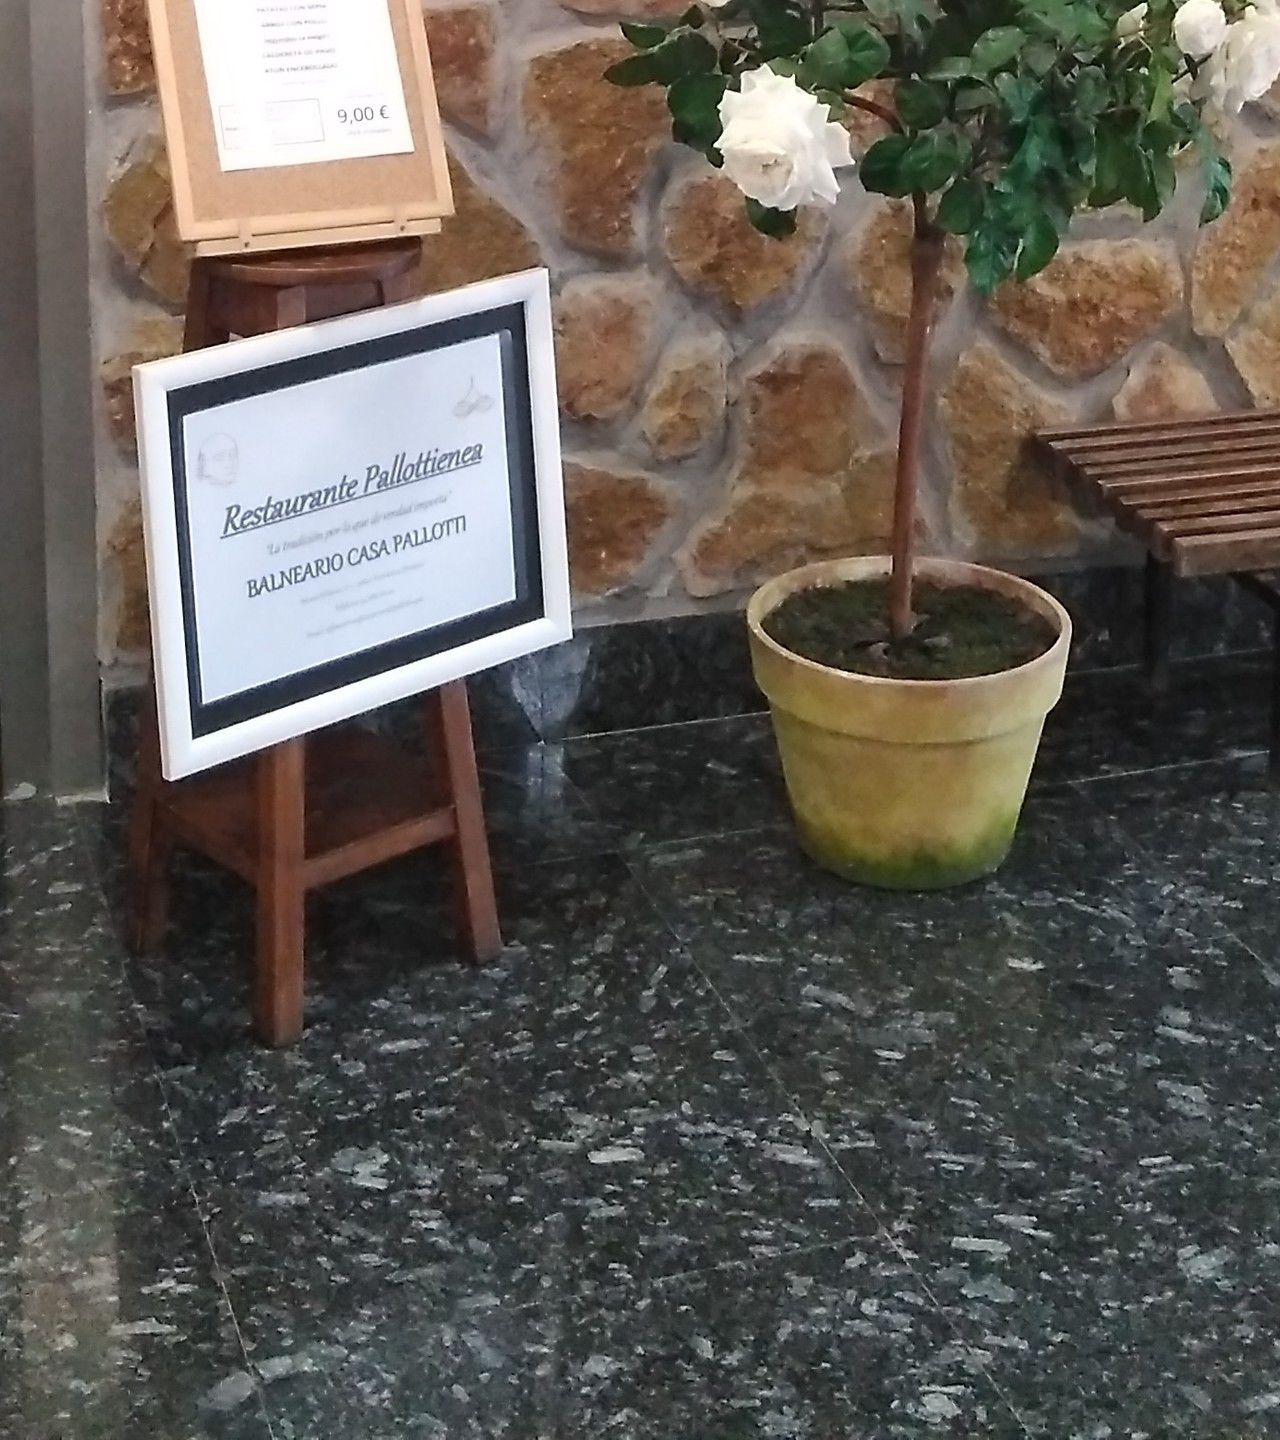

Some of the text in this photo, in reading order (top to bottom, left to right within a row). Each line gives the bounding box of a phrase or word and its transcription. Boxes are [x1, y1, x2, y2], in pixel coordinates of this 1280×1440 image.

[337, 105, 390, 124] 9,00 €
[222, 443, 483, 537] Restaurante Pallottienea
[246, 552, 344, 598] BALNEARIO
[347, 539, 391, 567] CASA
[392, 514, 467, 554] PALLOTTI
